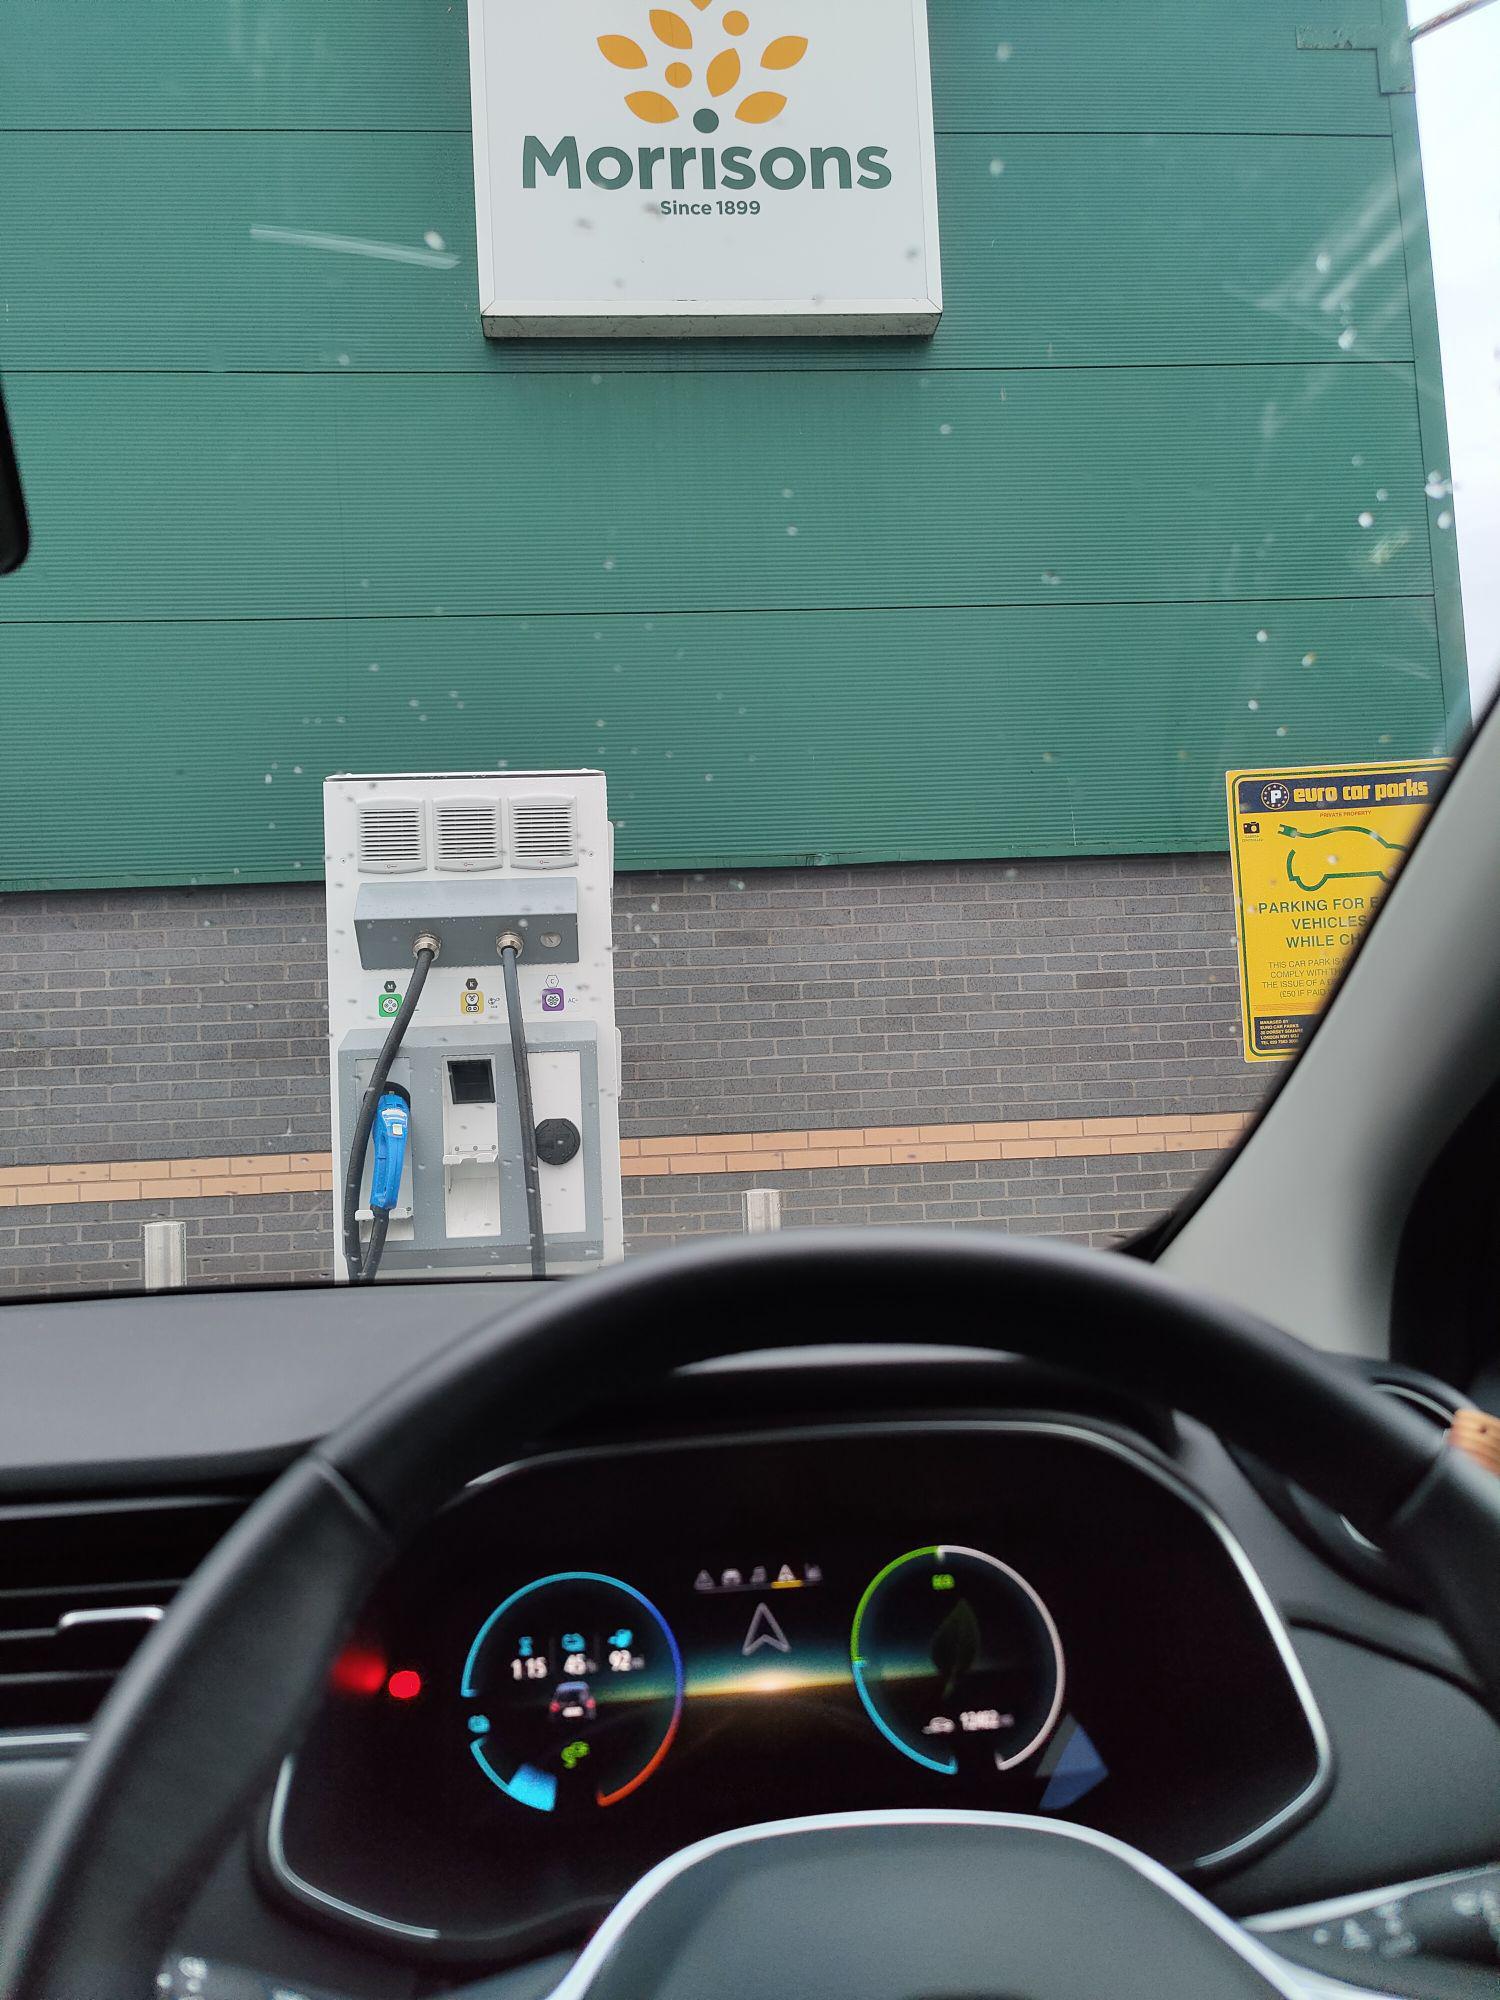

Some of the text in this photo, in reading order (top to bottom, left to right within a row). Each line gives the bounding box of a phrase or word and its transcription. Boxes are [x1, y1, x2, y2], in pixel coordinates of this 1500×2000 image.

[522, 135, 892, 190] Morrisons
[660, 200, 761, 215] Since 1899
[1293, 786, 1338, 803] euro
[1342, 784, 1370, 801] car
[1374, 779, 1428, 801] parks
[1258, 899, 1328, 914] PARKING
[1333, 897, 1364, 910] FOR
[1291, 915, 1367, 930] VEHICLES
[1286, 934, 1334, 948] WHILE
[1269, 961, 1287, 969] THIS
[1288, 960, 1305, 968] CAR
[1308, 958, 1330, 967] PARK
[1270, 970, 1305, 978] COMPLY
[1306, 968, 1328, 977] WITH
[1262, 981, 1278, 989] THE
[1280, 979, 1304, 988] ISSUE
[1305, 979, 1317, 987] OF
[1319, 978, 1326, 986] A
[1297, 989, 1305, 997] IF
[1306, 988, 1326, 997] PAID
